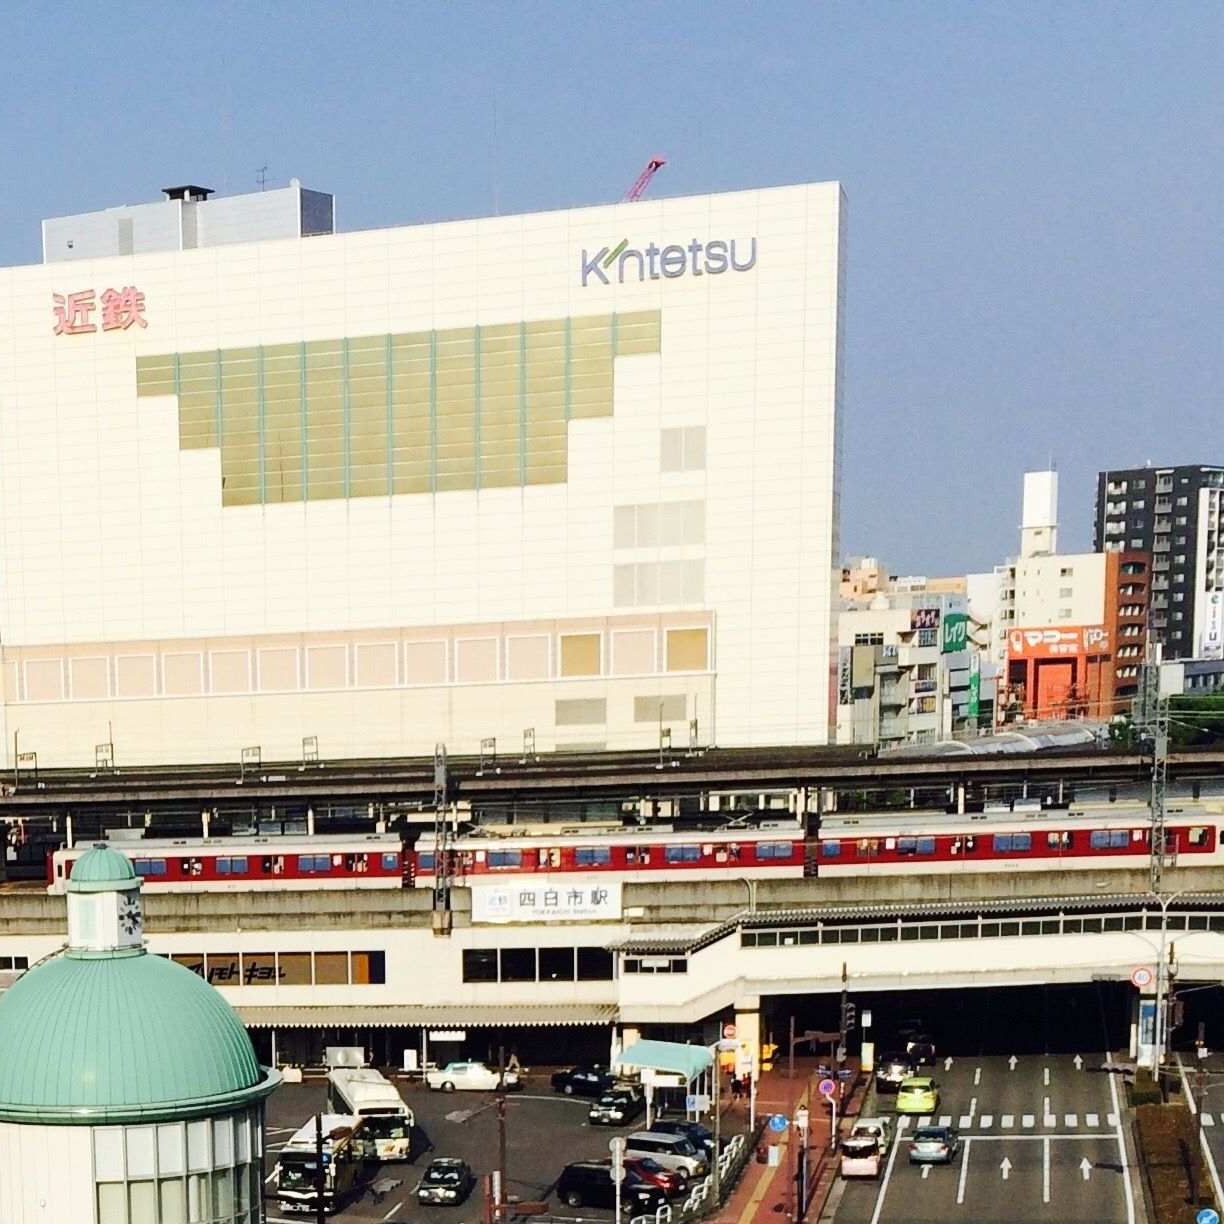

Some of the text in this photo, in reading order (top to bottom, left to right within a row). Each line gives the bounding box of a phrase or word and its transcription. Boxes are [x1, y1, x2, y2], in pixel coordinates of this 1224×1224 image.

[52, 286, 149, 336] 近鉄
[945, 621, 966, 643] レイク
